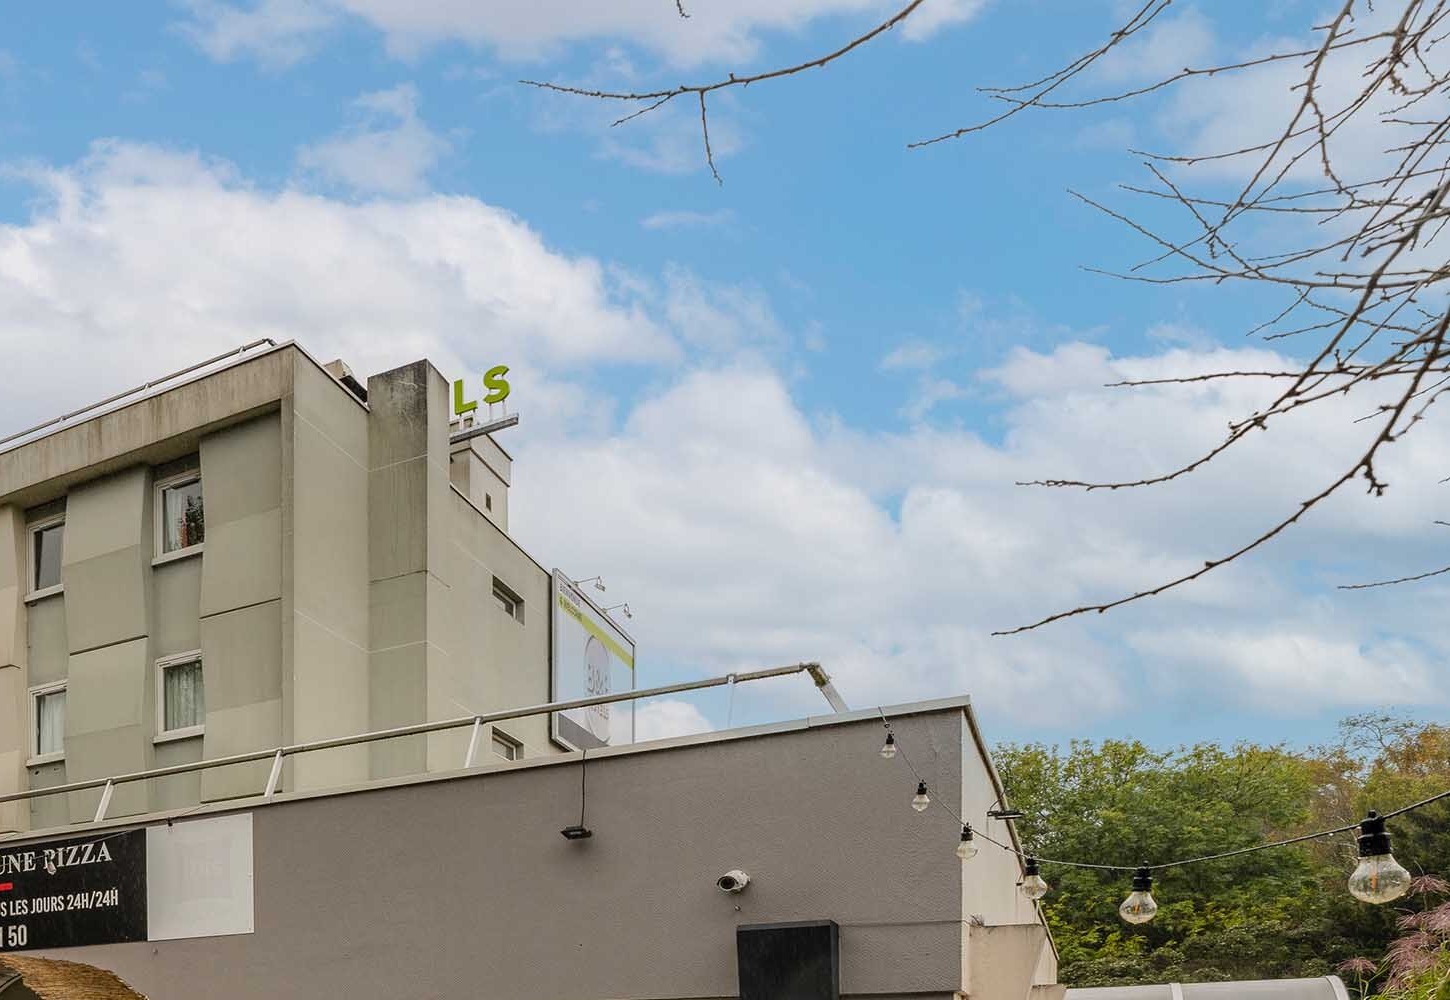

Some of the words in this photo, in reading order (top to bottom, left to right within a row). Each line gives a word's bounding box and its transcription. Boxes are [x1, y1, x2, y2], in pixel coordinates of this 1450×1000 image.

[43, 841, 112, 870] PIZZA
[10, 899, 28, 916] LES
[31, 896, 65, 914] JOURS
[67, 889, 119, 911] 24H/24H
[8, 924, 28, 946] 50
